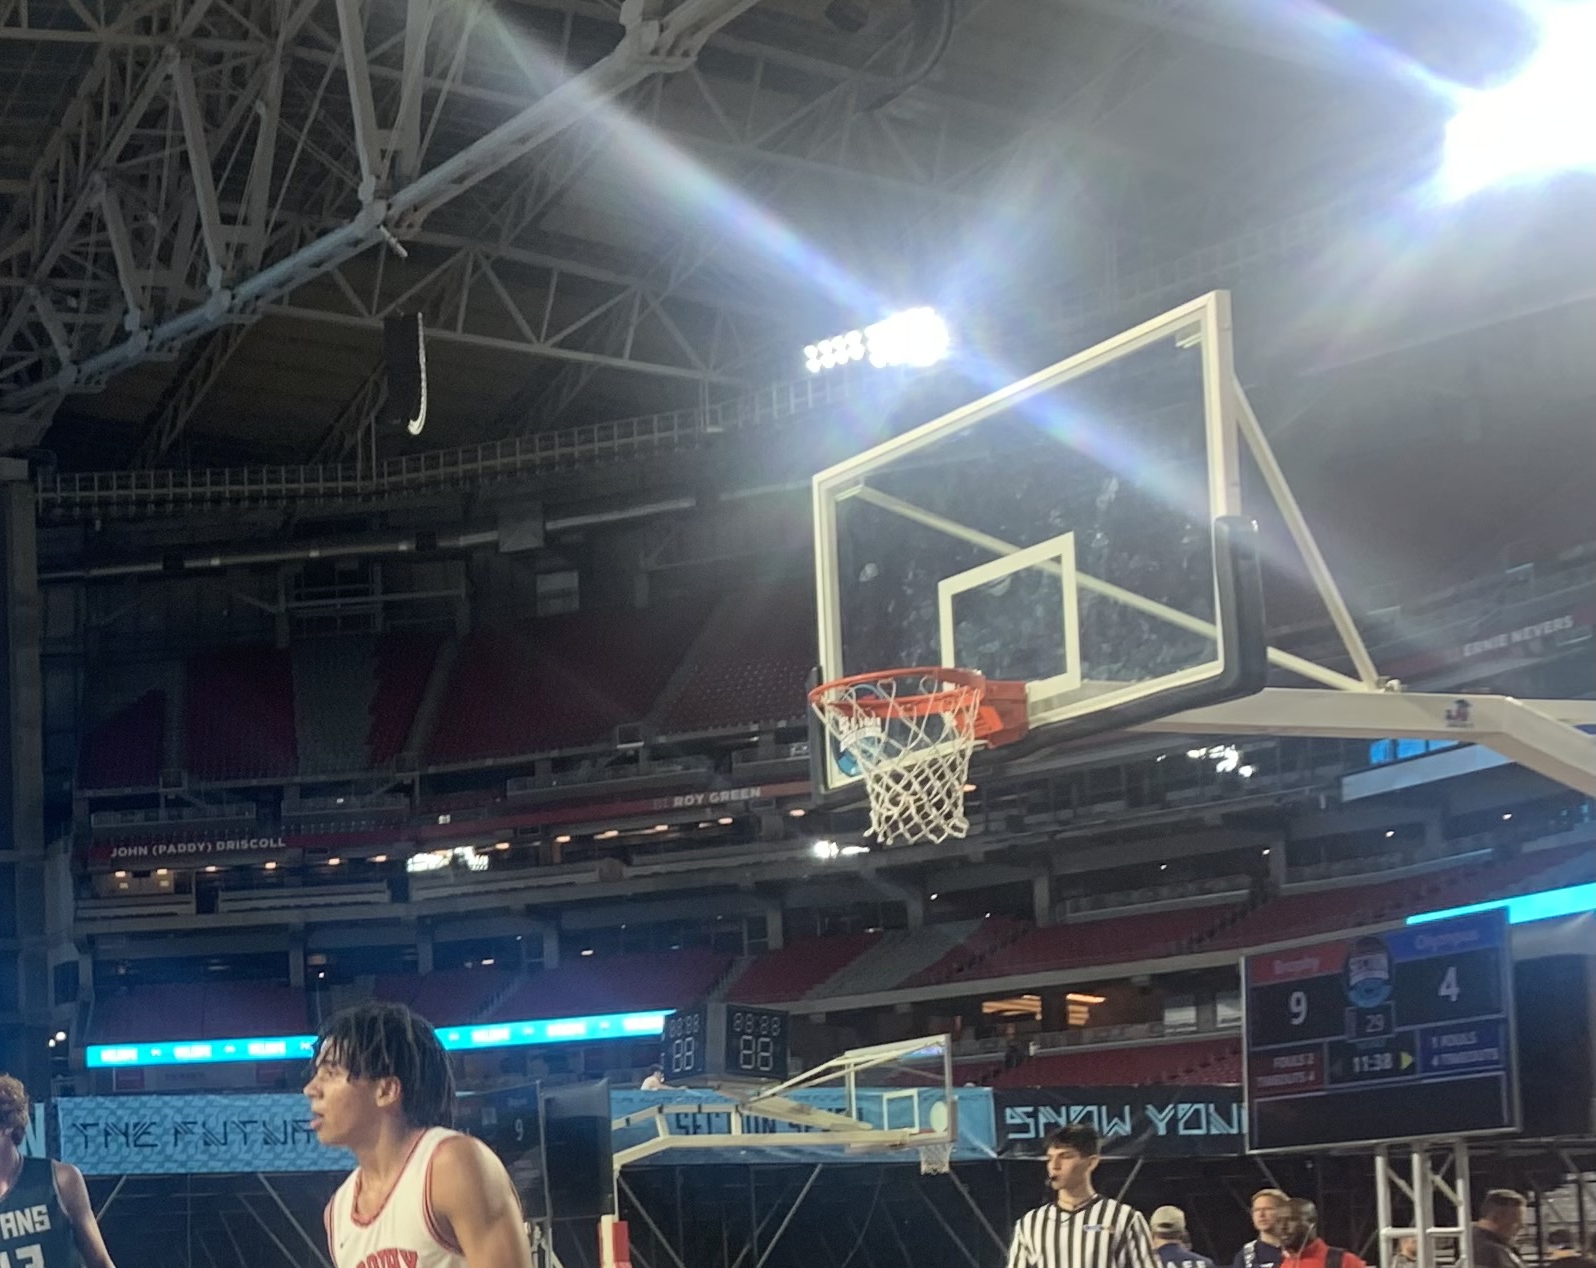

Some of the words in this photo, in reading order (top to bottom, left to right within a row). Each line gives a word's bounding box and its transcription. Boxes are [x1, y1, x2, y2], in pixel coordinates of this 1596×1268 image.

[673, 795, 704, 808] ROY
[709, 787, 761, 803] GREEN
[111, 846, 148, 858] JOHN
[152, 842, 212, 856] (PADDY)
[216, 837, 286, 852] DRISCOLL
[1439, 966, 1460, 1002] 4
[1290, 991, 1308, 1025] 9
[1365, 1014, 1385, 1033] 29
[71, 1121, 159, 1149] THE
[173, 1120, 315, 1147] FUTUR
